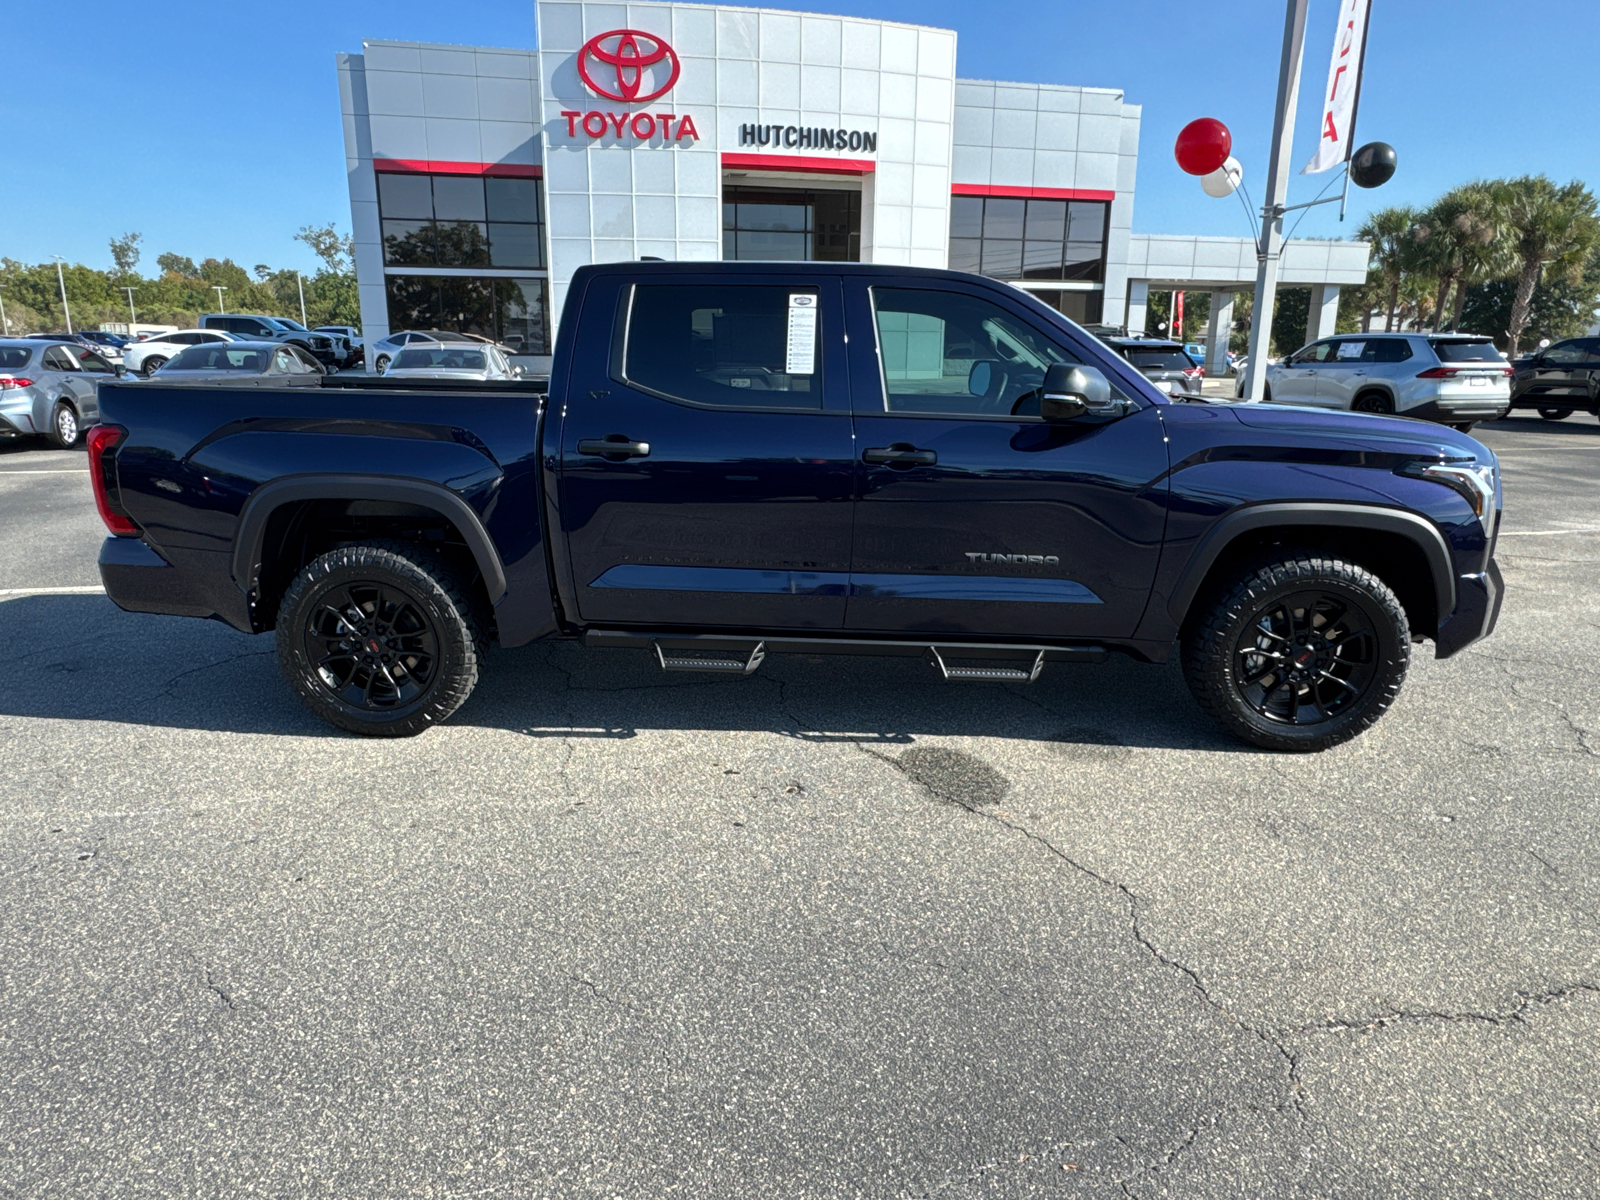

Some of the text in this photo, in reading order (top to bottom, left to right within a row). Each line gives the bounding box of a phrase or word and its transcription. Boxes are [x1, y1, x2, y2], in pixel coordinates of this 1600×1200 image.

[560, 110, 700, 141] TOYOTA
[741, 122, 877, 153] HUTCHINSON
[964, 552, 1060, 566] TUNDRA
